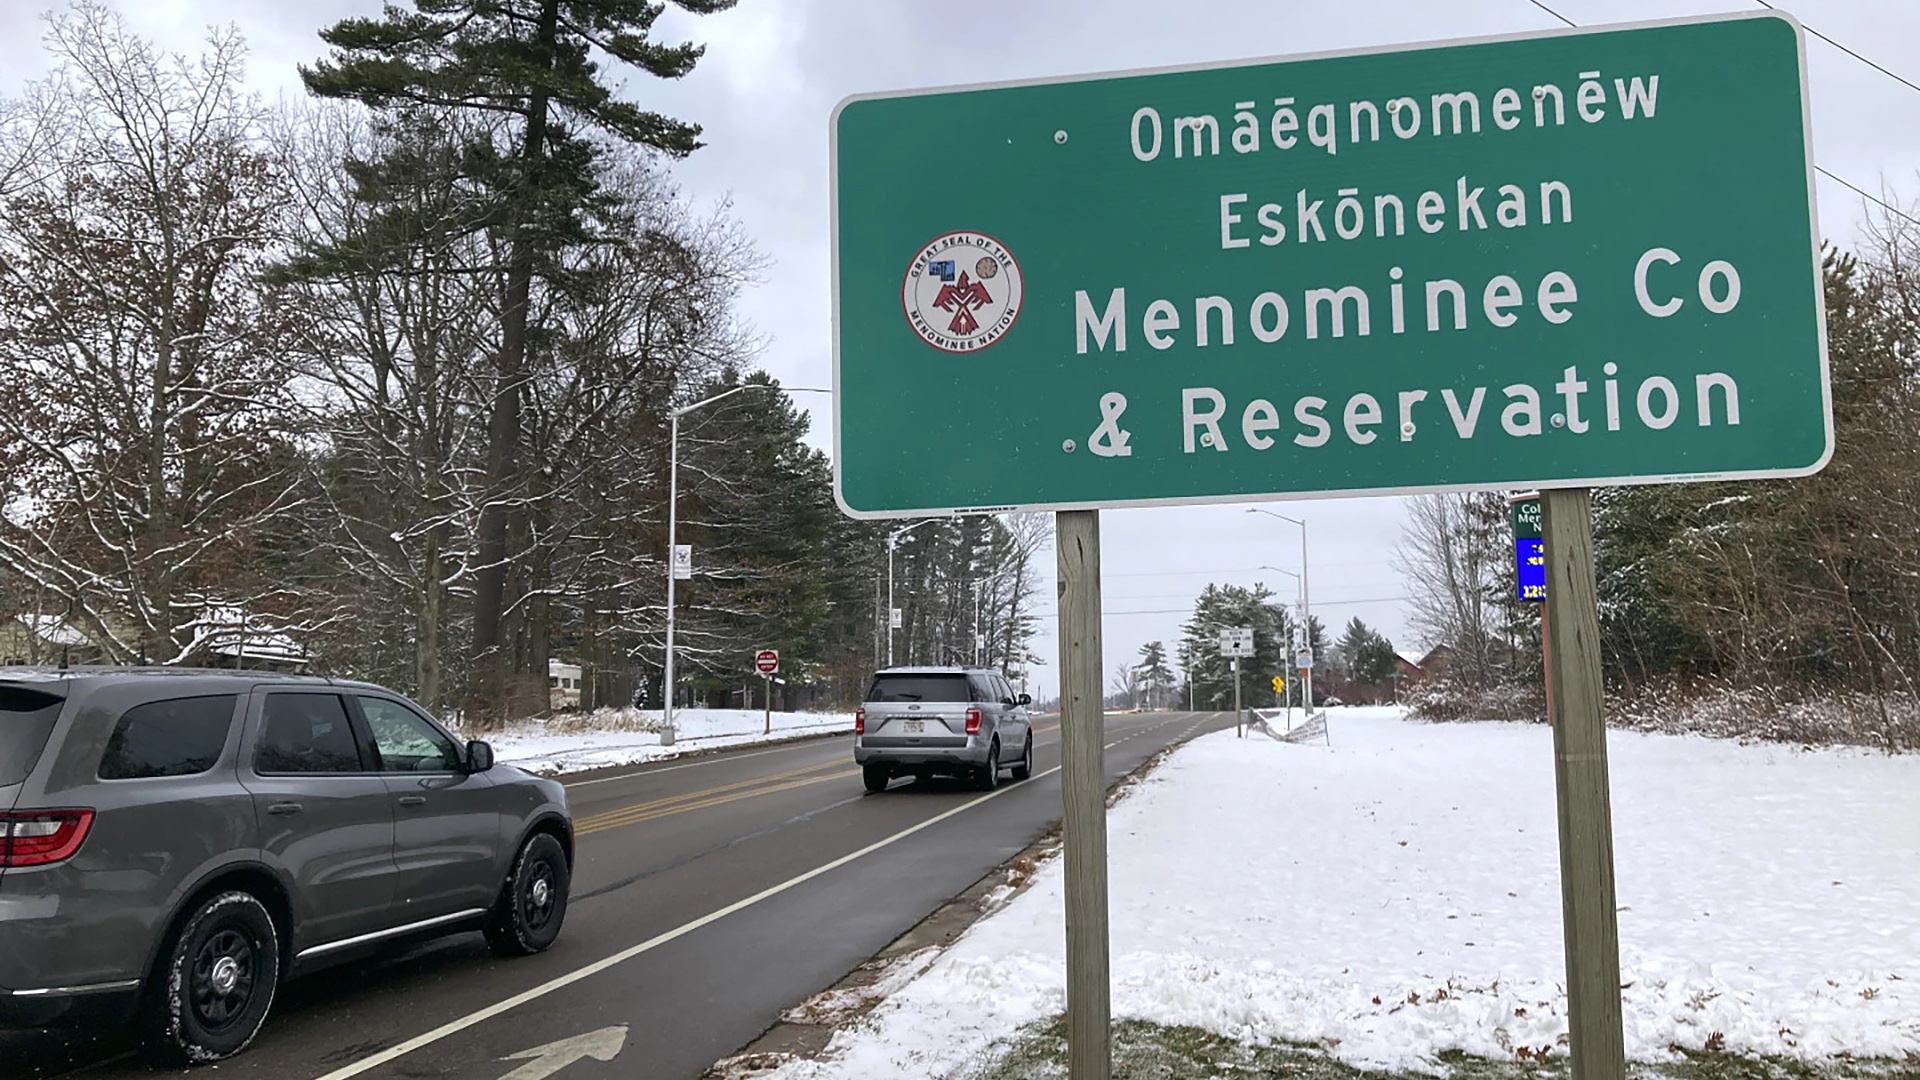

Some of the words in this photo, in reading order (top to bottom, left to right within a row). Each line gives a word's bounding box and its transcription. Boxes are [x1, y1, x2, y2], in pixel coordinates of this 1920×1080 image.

[1220, 175, 1573, 249] Eskōnekan
[911, 245, 938, 278] GREAT
[942, 236, 971, 248] SEAL
[976, 238, 991, 249] OF
[994, 248, 1012, 268] THE
[911, 311, 974, 349] MENOMINEE
[978, 308, 1015, 345] NATION
[1074, 266, 1578, 355] Menominee
[1634, 247, 1741, 318] Co
[1087, 392, 1132, 457] &
[1182, 362, 1741, 453] Reservation
